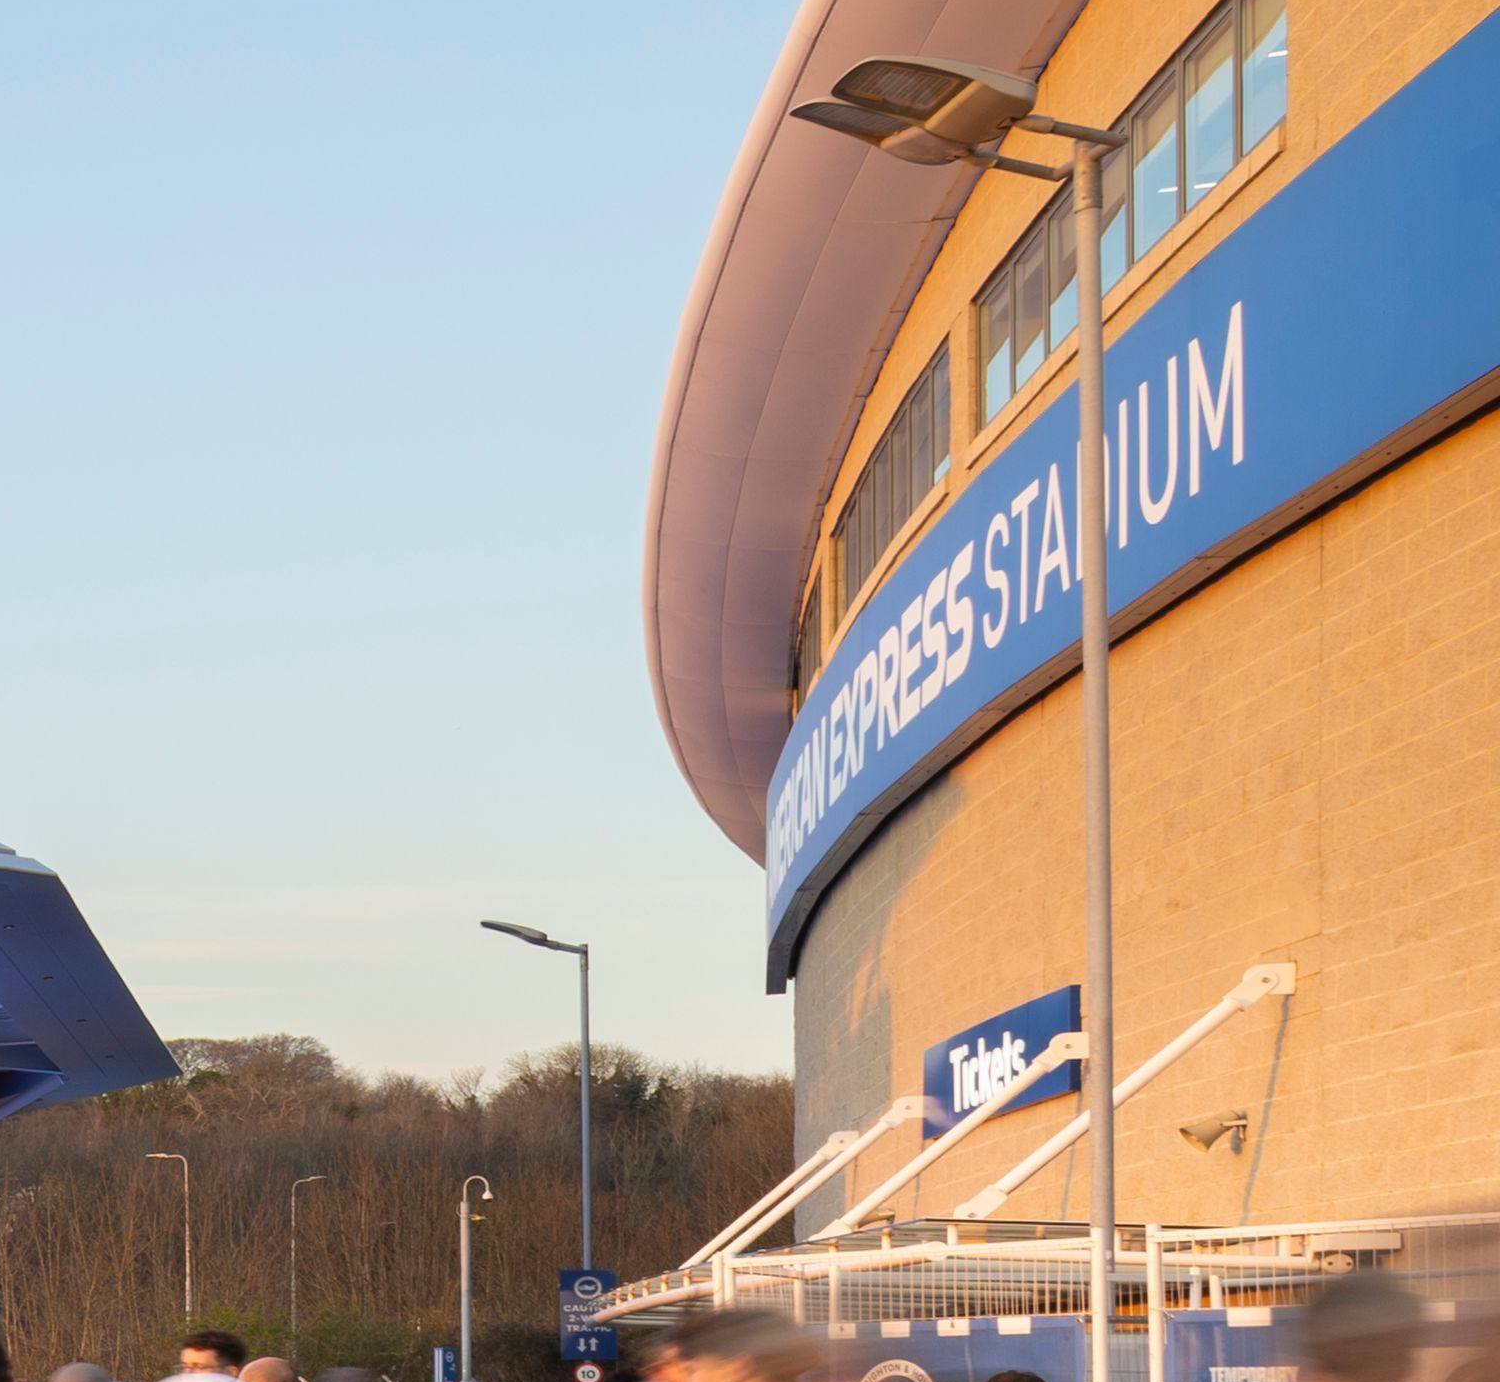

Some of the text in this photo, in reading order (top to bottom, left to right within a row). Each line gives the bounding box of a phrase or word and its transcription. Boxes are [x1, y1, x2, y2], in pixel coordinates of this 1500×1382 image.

[768, 301, 1244, 907] MERICAN EXPRESS STAIUM
[949, 1031, 1027, 1113] Tickets
[580, 1369, 596, 1380] 10
